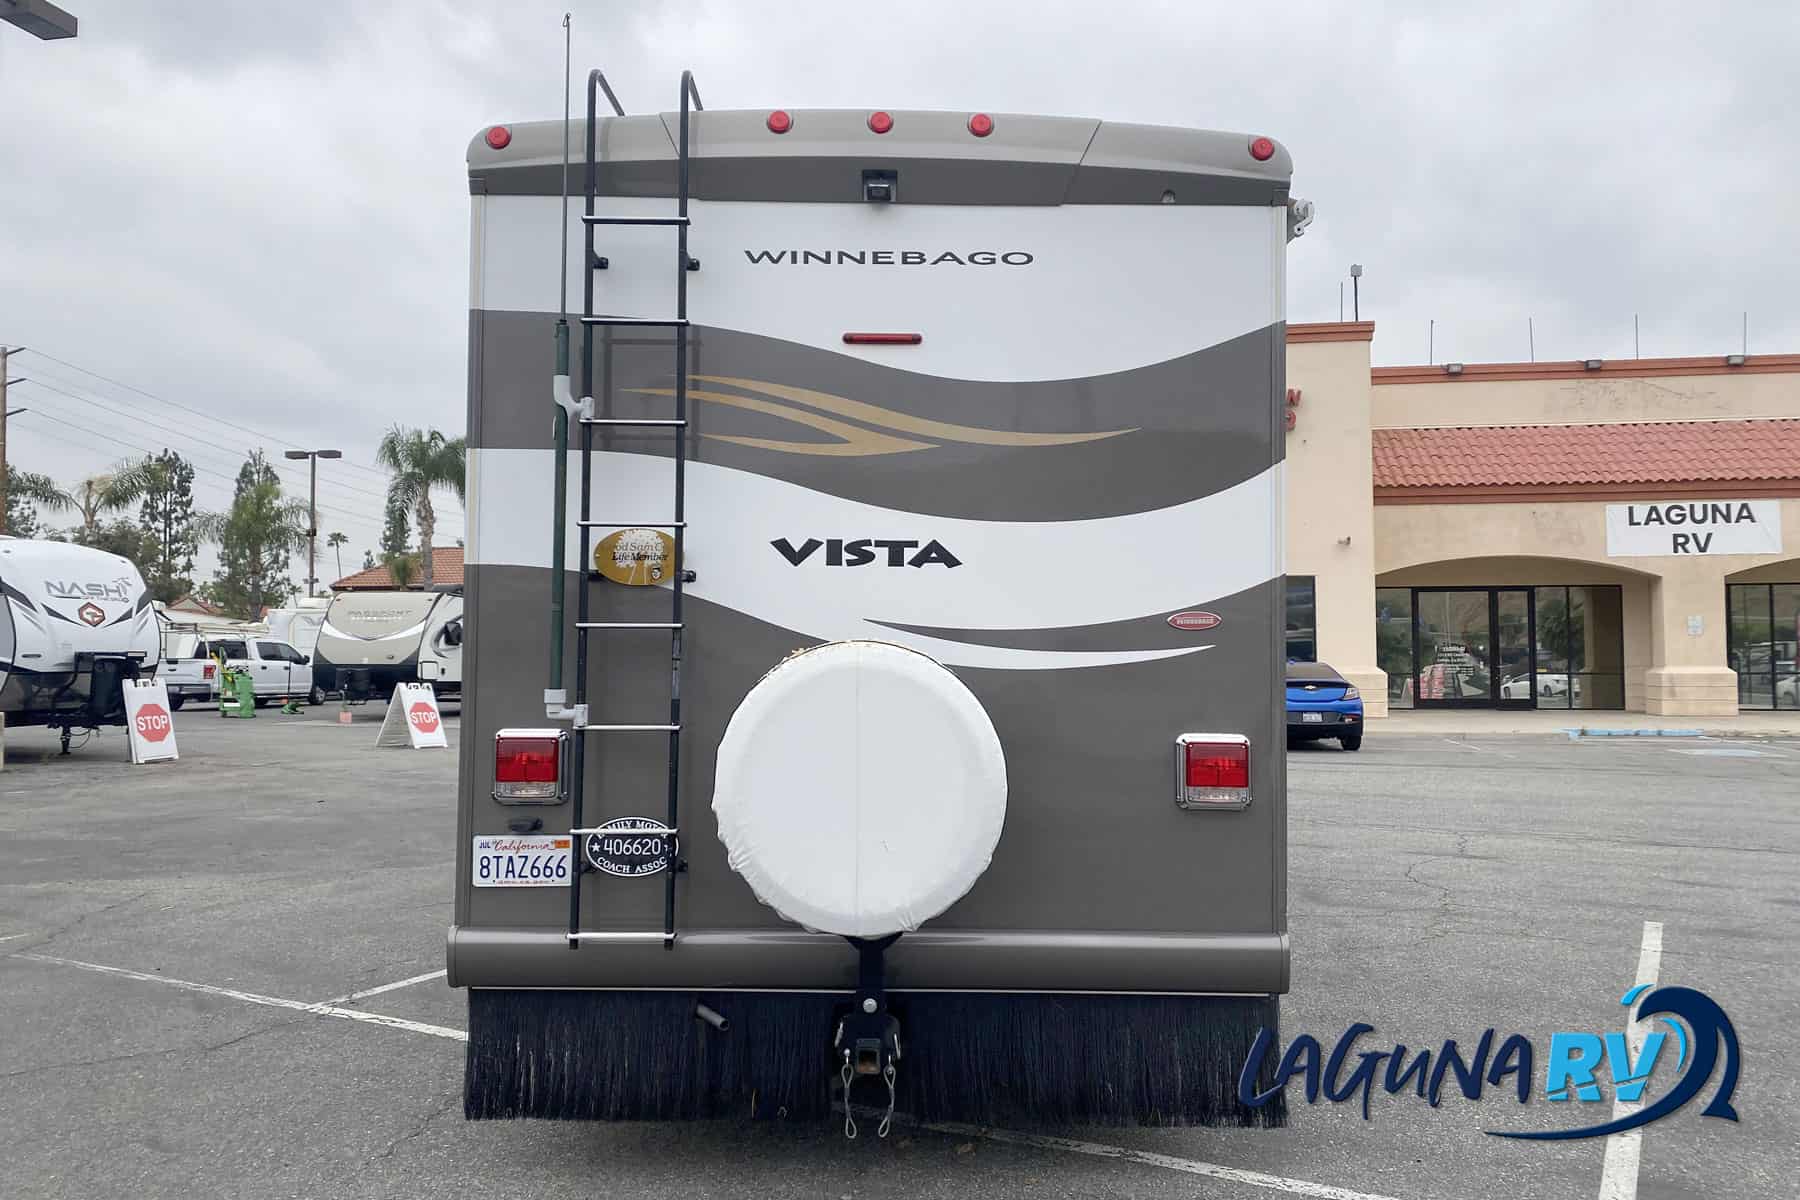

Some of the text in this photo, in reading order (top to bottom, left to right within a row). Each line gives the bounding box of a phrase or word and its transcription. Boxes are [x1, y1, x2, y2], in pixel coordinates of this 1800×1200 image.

[743, 249, 1034, 266] WINNEBAGO
[1627, 502, 1757, 526] LAGUNA
[1671, 532, 1713, 554] RV
[769, 537, 963, 568] VISTA
[44, 580, 122, 597] NASH
[136, 715, 168, 731] STOP
[410, 711, 437, 724] STOP
[494, 839, 556, 855] California
[603, 838, 661, 855] 406620
[479, 855, 567, 879] 8TAZ666
[597, 856, 630, 873] COACH
